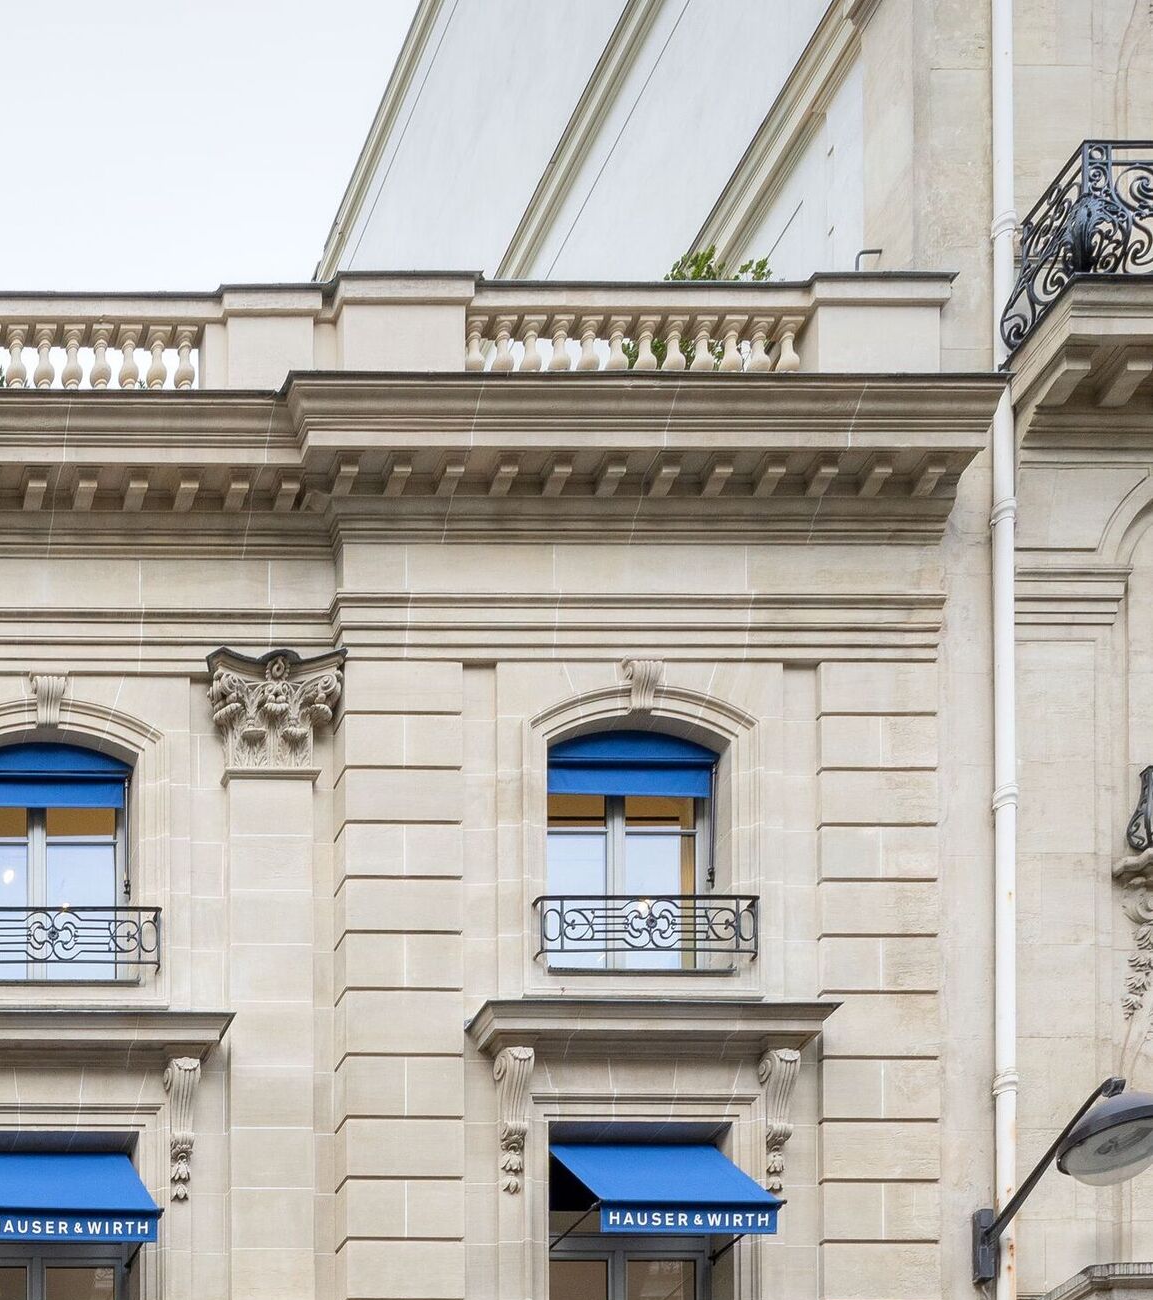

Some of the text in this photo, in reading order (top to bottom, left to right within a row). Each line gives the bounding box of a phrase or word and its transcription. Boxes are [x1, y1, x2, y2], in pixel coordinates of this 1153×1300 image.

[609, 1211, 770, 1227] HAUSER & WIRTH
[73, 1222, 84, 1234] &
[87, 1221, 149, 1235] WIRTH
